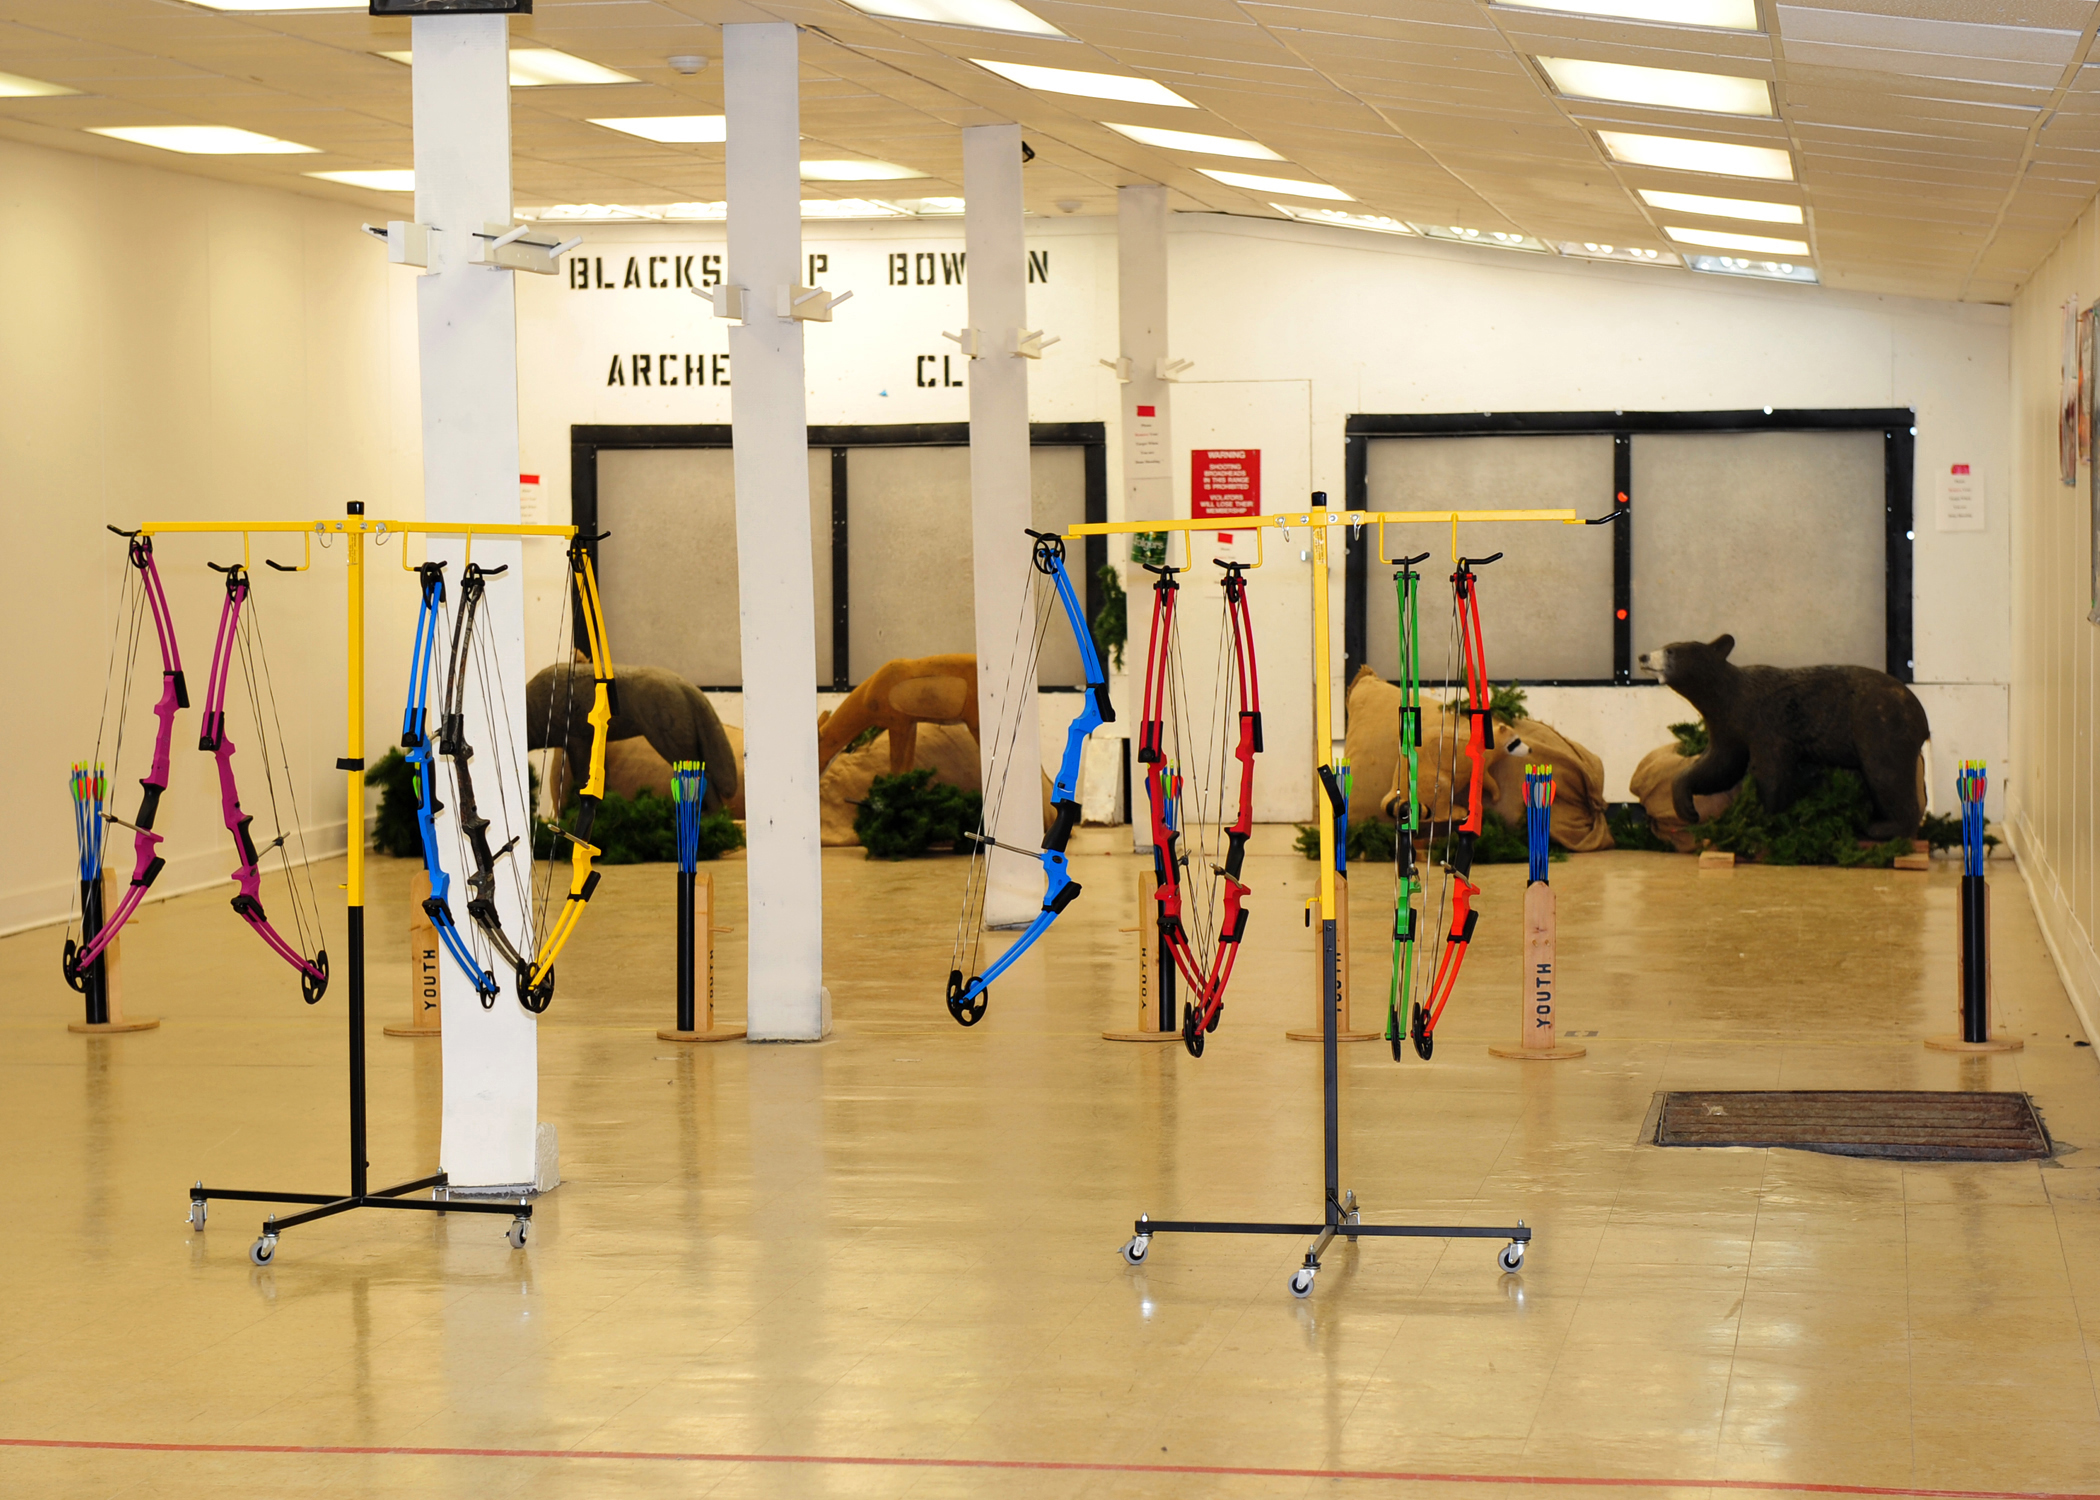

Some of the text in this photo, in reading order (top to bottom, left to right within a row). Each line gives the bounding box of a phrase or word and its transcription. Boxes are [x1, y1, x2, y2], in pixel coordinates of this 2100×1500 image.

[570, 250, 1049, 289] BLACKSP BOWN
[607, 354, 963, 388] ARCHE CL
[1207, 451, 1246, 459] WARNING
[423, 949, 437, 1011] YOUTH
[1536, 963, 1551, 1028] YOUTH
